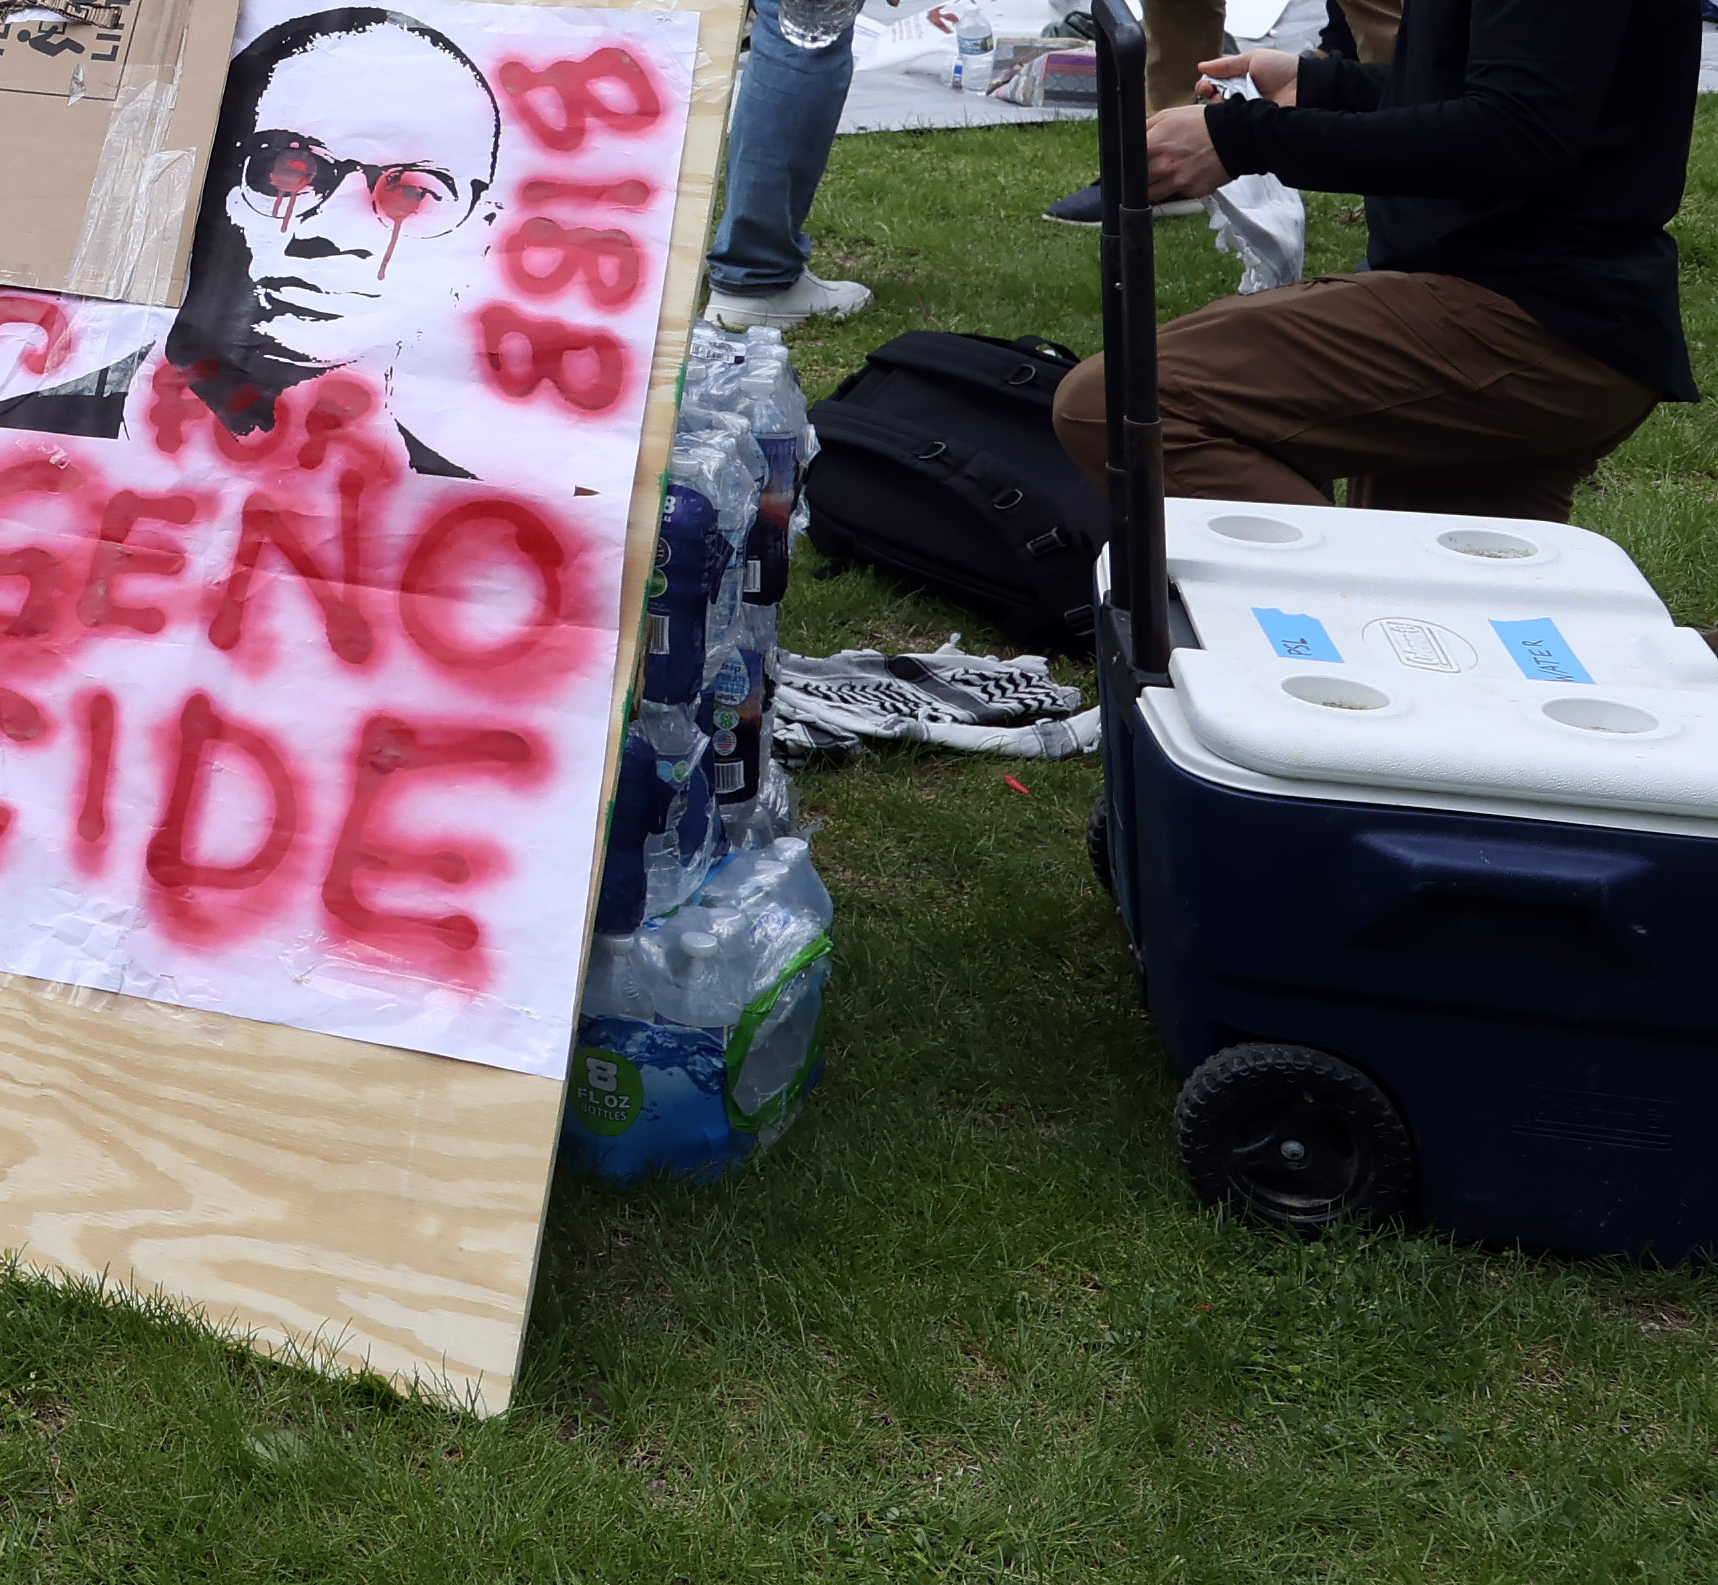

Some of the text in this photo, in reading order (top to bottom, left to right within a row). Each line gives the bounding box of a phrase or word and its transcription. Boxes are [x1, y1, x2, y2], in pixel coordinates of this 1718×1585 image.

[478, 46, 661, 412] BIBB
[147, 358, 395, 480] FOR
[586, 1057, 618, 1092] 8
[577, 1087, 631, 1109] FL OZ
[580, 1103, 629, 1121] BOTTLES
